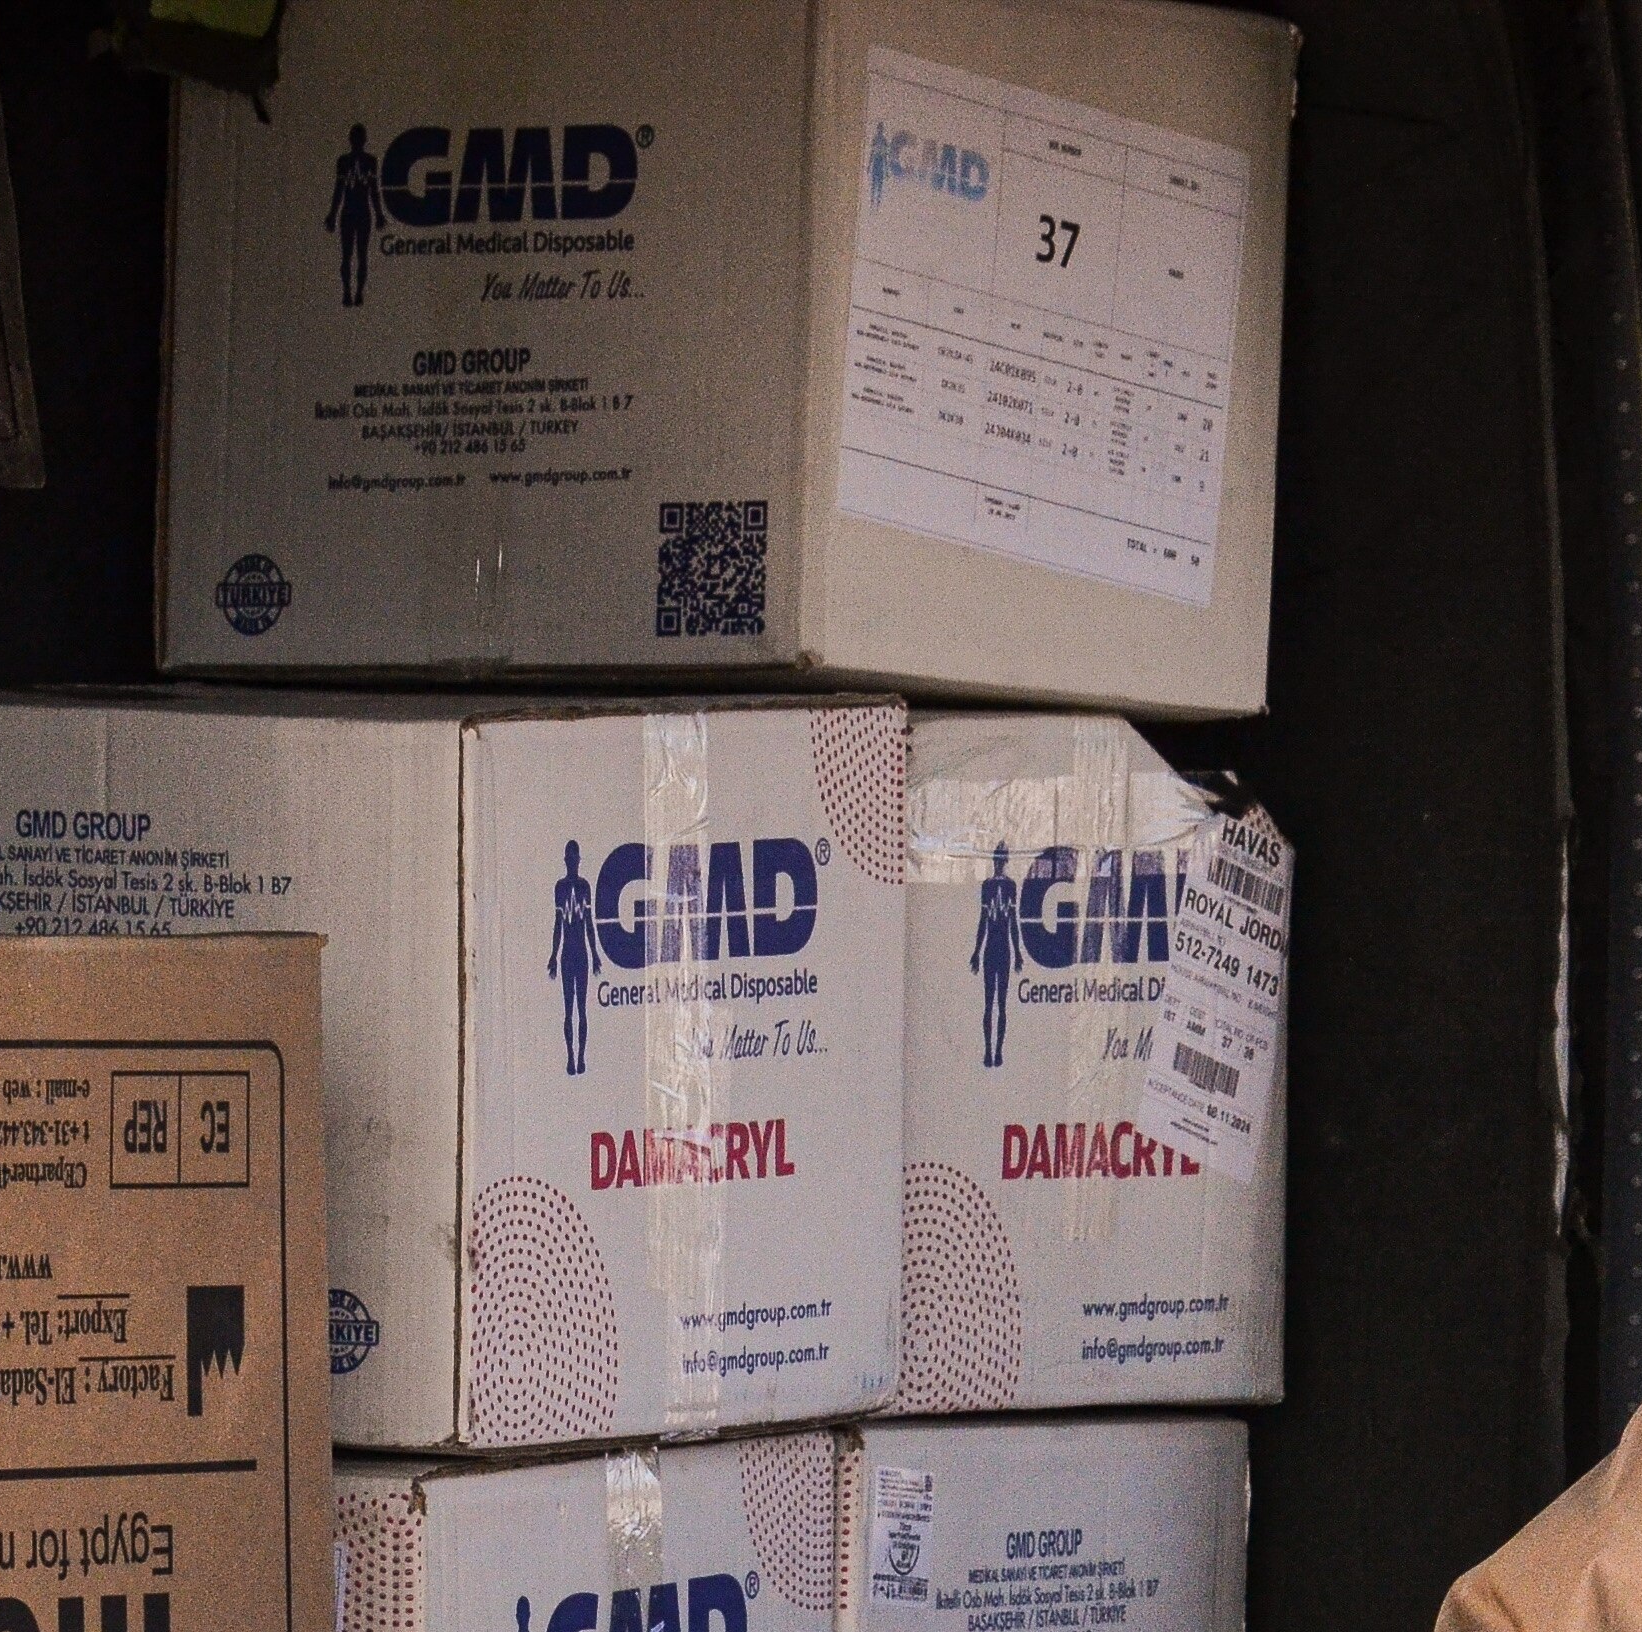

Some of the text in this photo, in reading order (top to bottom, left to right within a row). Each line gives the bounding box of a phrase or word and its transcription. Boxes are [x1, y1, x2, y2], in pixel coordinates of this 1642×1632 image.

[382, 124, 639, 227] GMD
[381, 227, 635, 256] General Medical Disposable
[1035, 213, 1082, 269] 37
[481, 272, 513, 301] You
[519, 272, 575, 301] Matter
[579, 269, 602, 300] To
[412, 347, 532, 377] GMD GROUP
[488, 466, 633, 488] www.gmdgroup.com.tr
[15, 809, 152, 842] GMD GROUP
[56, 848, 72, 864] VE
[66, 866, 118, 893] Sosyal
[121, 870, 157, 892] Tesis
[162, 873, 174, 892] 2
[177, 872, 199, 895] sk.
[202, 872, 252, 895] B-Blok
[271, 875, 292, 896] B7
[595, 837, 819, 969] GMD
[1017, 844, 1186, 968] GM
[1184, 887, 1234, 930] ROYAL
[14, 916, 45, 936] +90
[49, 917, 83, 936] 212
[88, 918, 119, 936] 486
[125, 920, 145, 935] 15
[1174, 930, 1241, 978] 512-7249
[1245, 963, 1280, 997] 1473
[597, 978, 661, 1008] General
[730, 967, 818, 1005] Disposable
[1017, 977, 1080, 1004] General
[1083, 975, 1144, 1003] Medical
[720, 1023, 769, 1061] Matter
[772, 1019, 791, 1058] To
[2, 1078, 33, 1104] web
[45, 1078, 91, 1106] e-mail
[123, 1099, 231, 1154] EC REP
[590, 1118, 796, 1192] DAMACRYL
[57, 1300, 128, 1345] Export:
[679, 1300, 833, 1333] www.gmdgroup.com.tr
[1081, 1293, 1230, 1322] www.gmdgroup.com.tr
[19, 1309, 54, 1347] Tel.
[681, 1340, 830, 1376] info@gmdgroup.com.tr
[1081, 1335, 1225, 1363] info@gmdgroup.com.tr
[96, 1360, 176, 1403] Factory
[25, 1528, 71, 1581] for
[78, 1510, 175, 1577] Egypt
[1006, 1527, 1083, 1560] GMD GROUP
